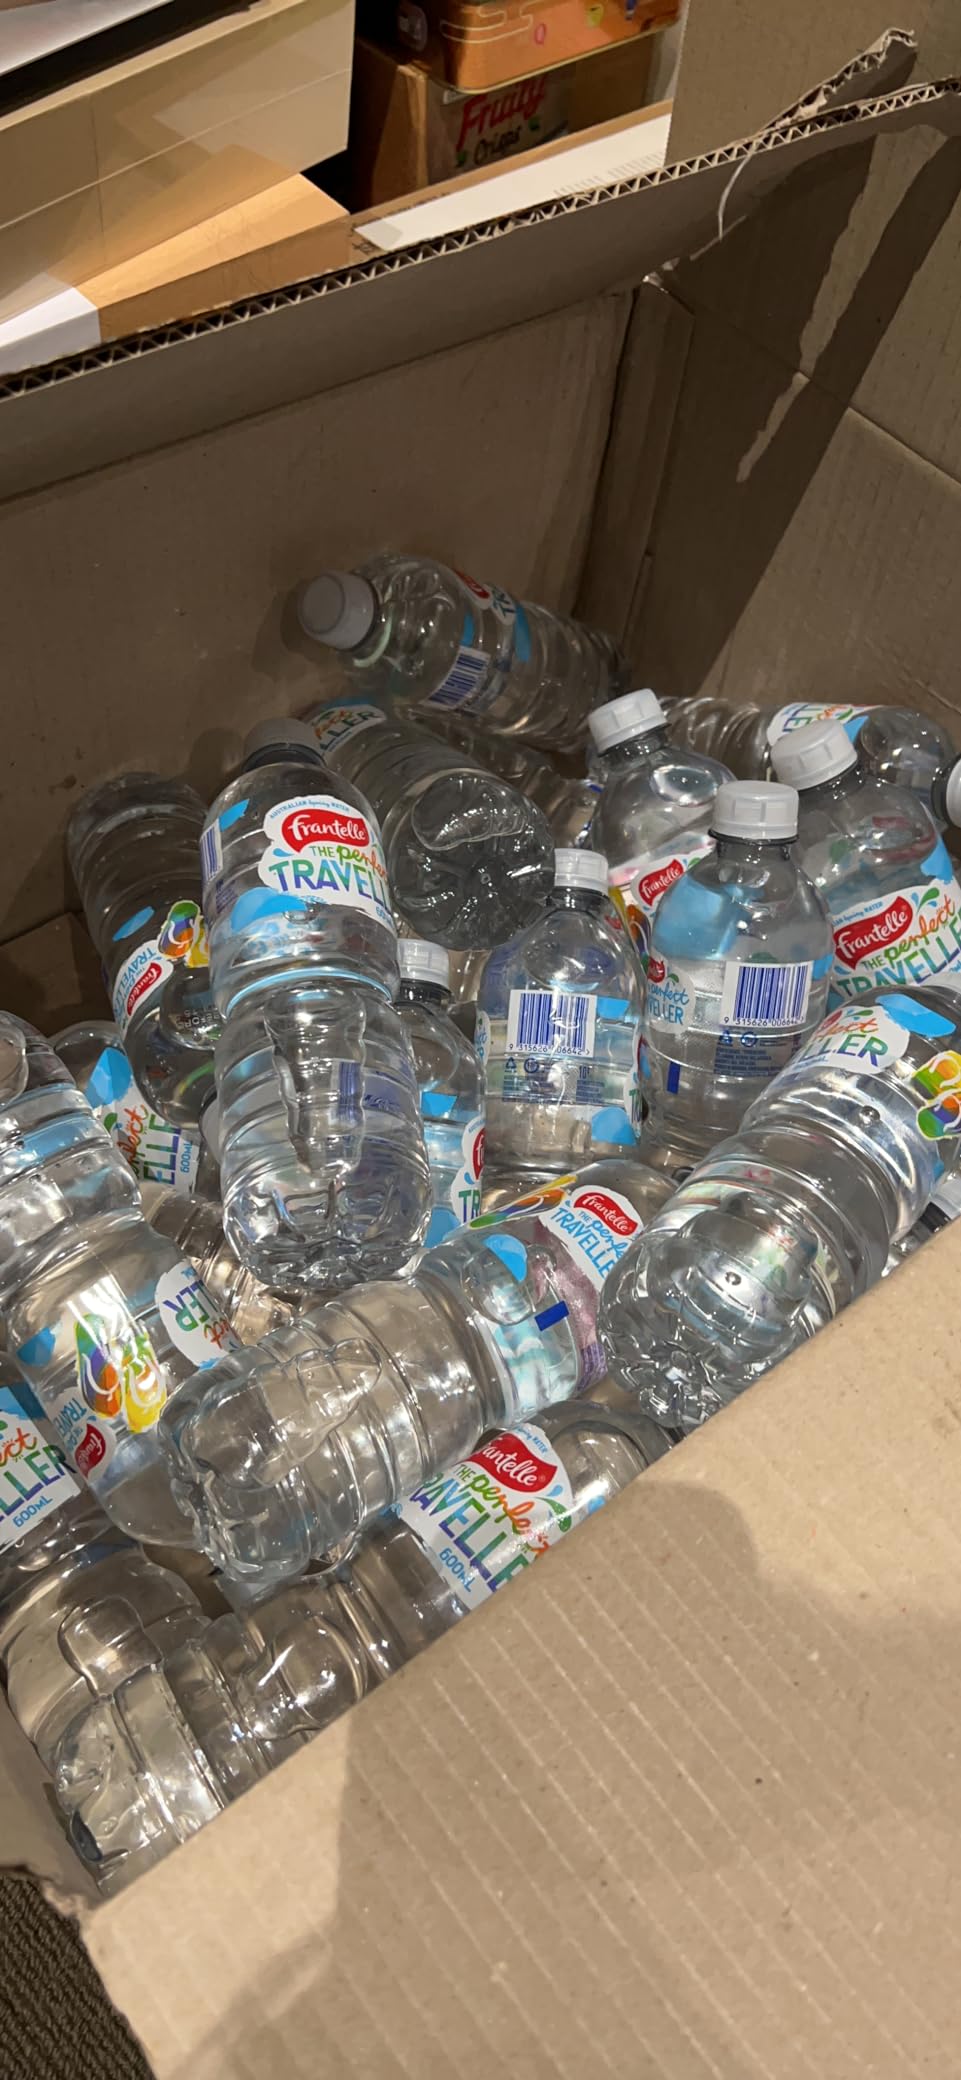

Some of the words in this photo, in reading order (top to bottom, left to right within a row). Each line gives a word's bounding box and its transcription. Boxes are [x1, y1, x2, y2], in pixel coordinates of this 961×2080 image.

[309, 845, 336, 858] THE
[860, 955, 884, 970] THE
[553, 1047, 583, 1056] 06642
[578, 1211, 593, 1223] THE
[582, 1194, 629, 1232] frantelle
[454, 1464, 477, 1482] THE
